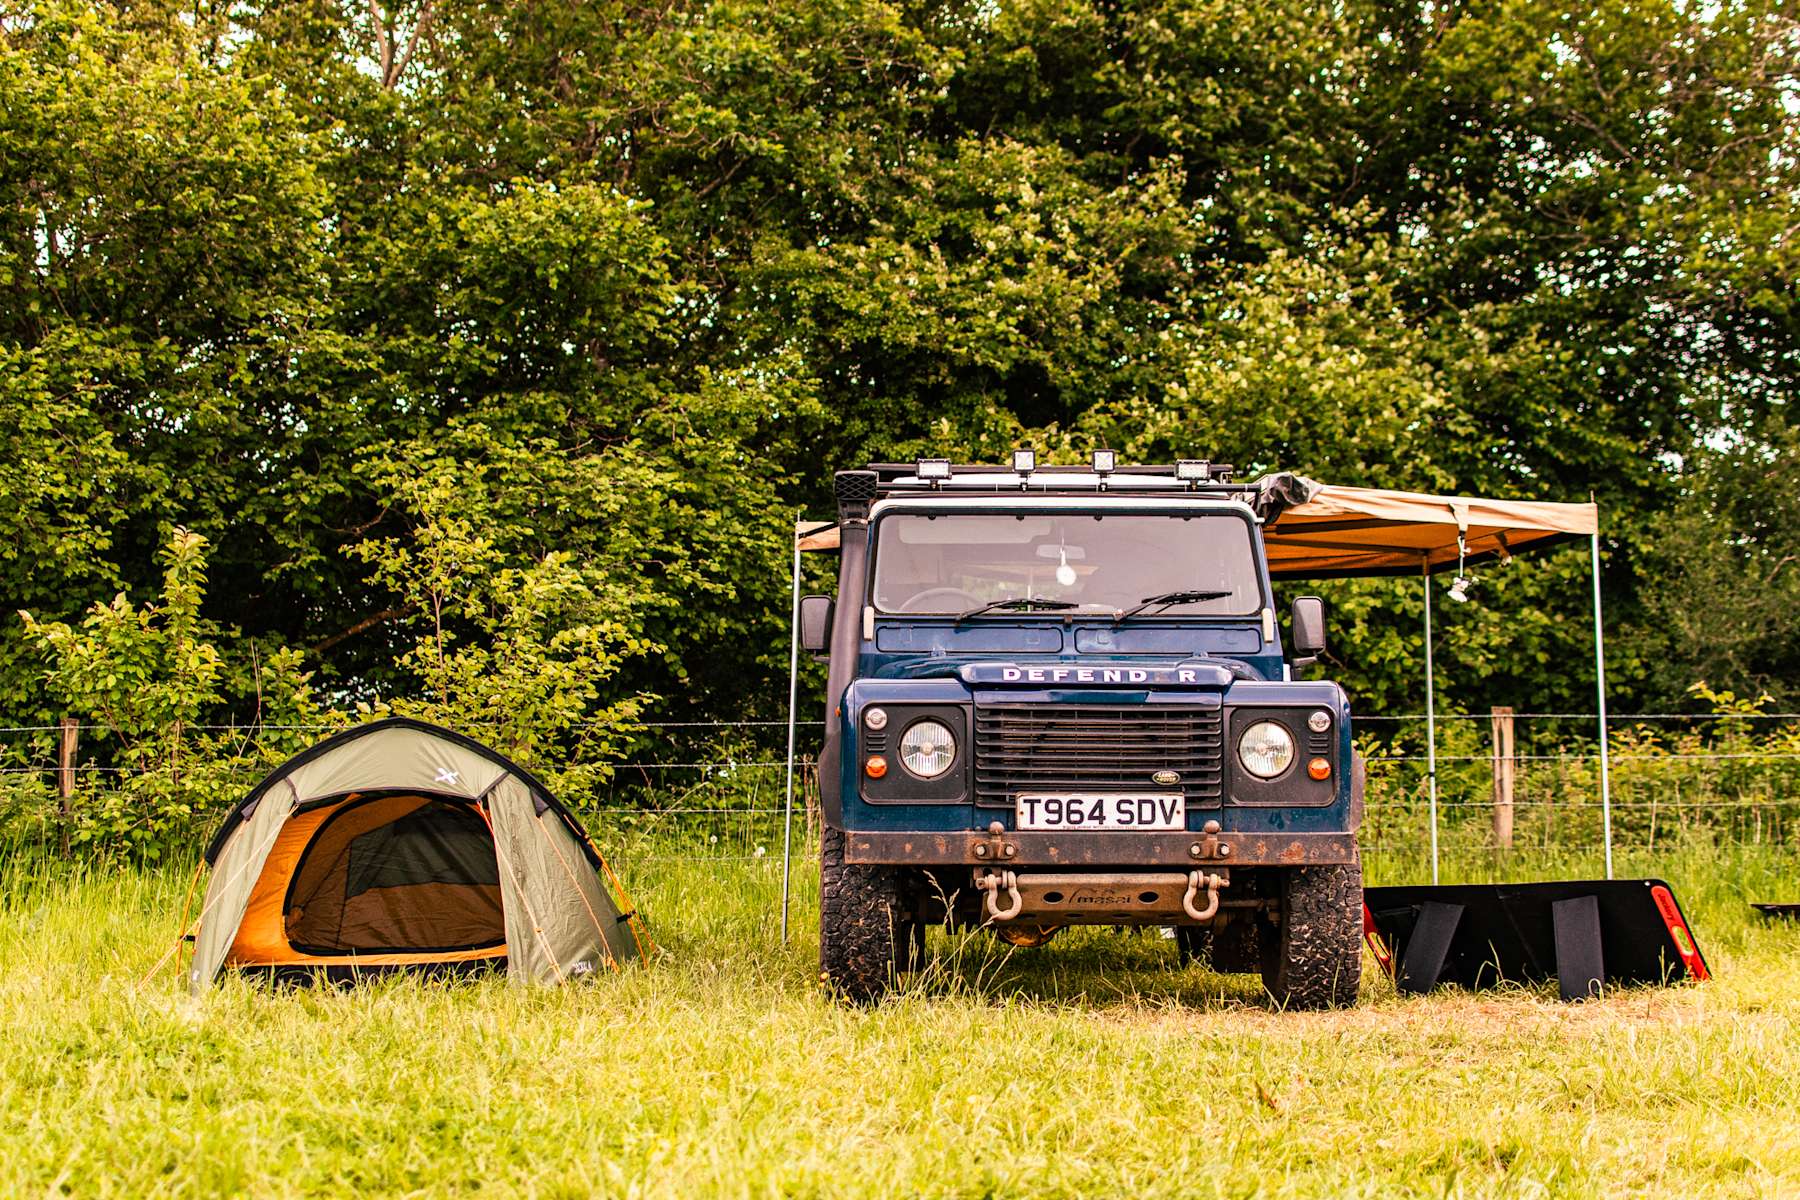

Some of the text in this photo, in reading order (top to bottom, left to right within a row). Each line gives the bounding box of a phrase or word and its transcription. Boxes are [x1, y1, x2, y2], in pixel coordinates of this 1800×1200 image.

[1003, 668, 1196, 682] DEFENDR
[1023, 799, 1177, 825] T964 SDV
[1077, 895, 1131, 904] masai
